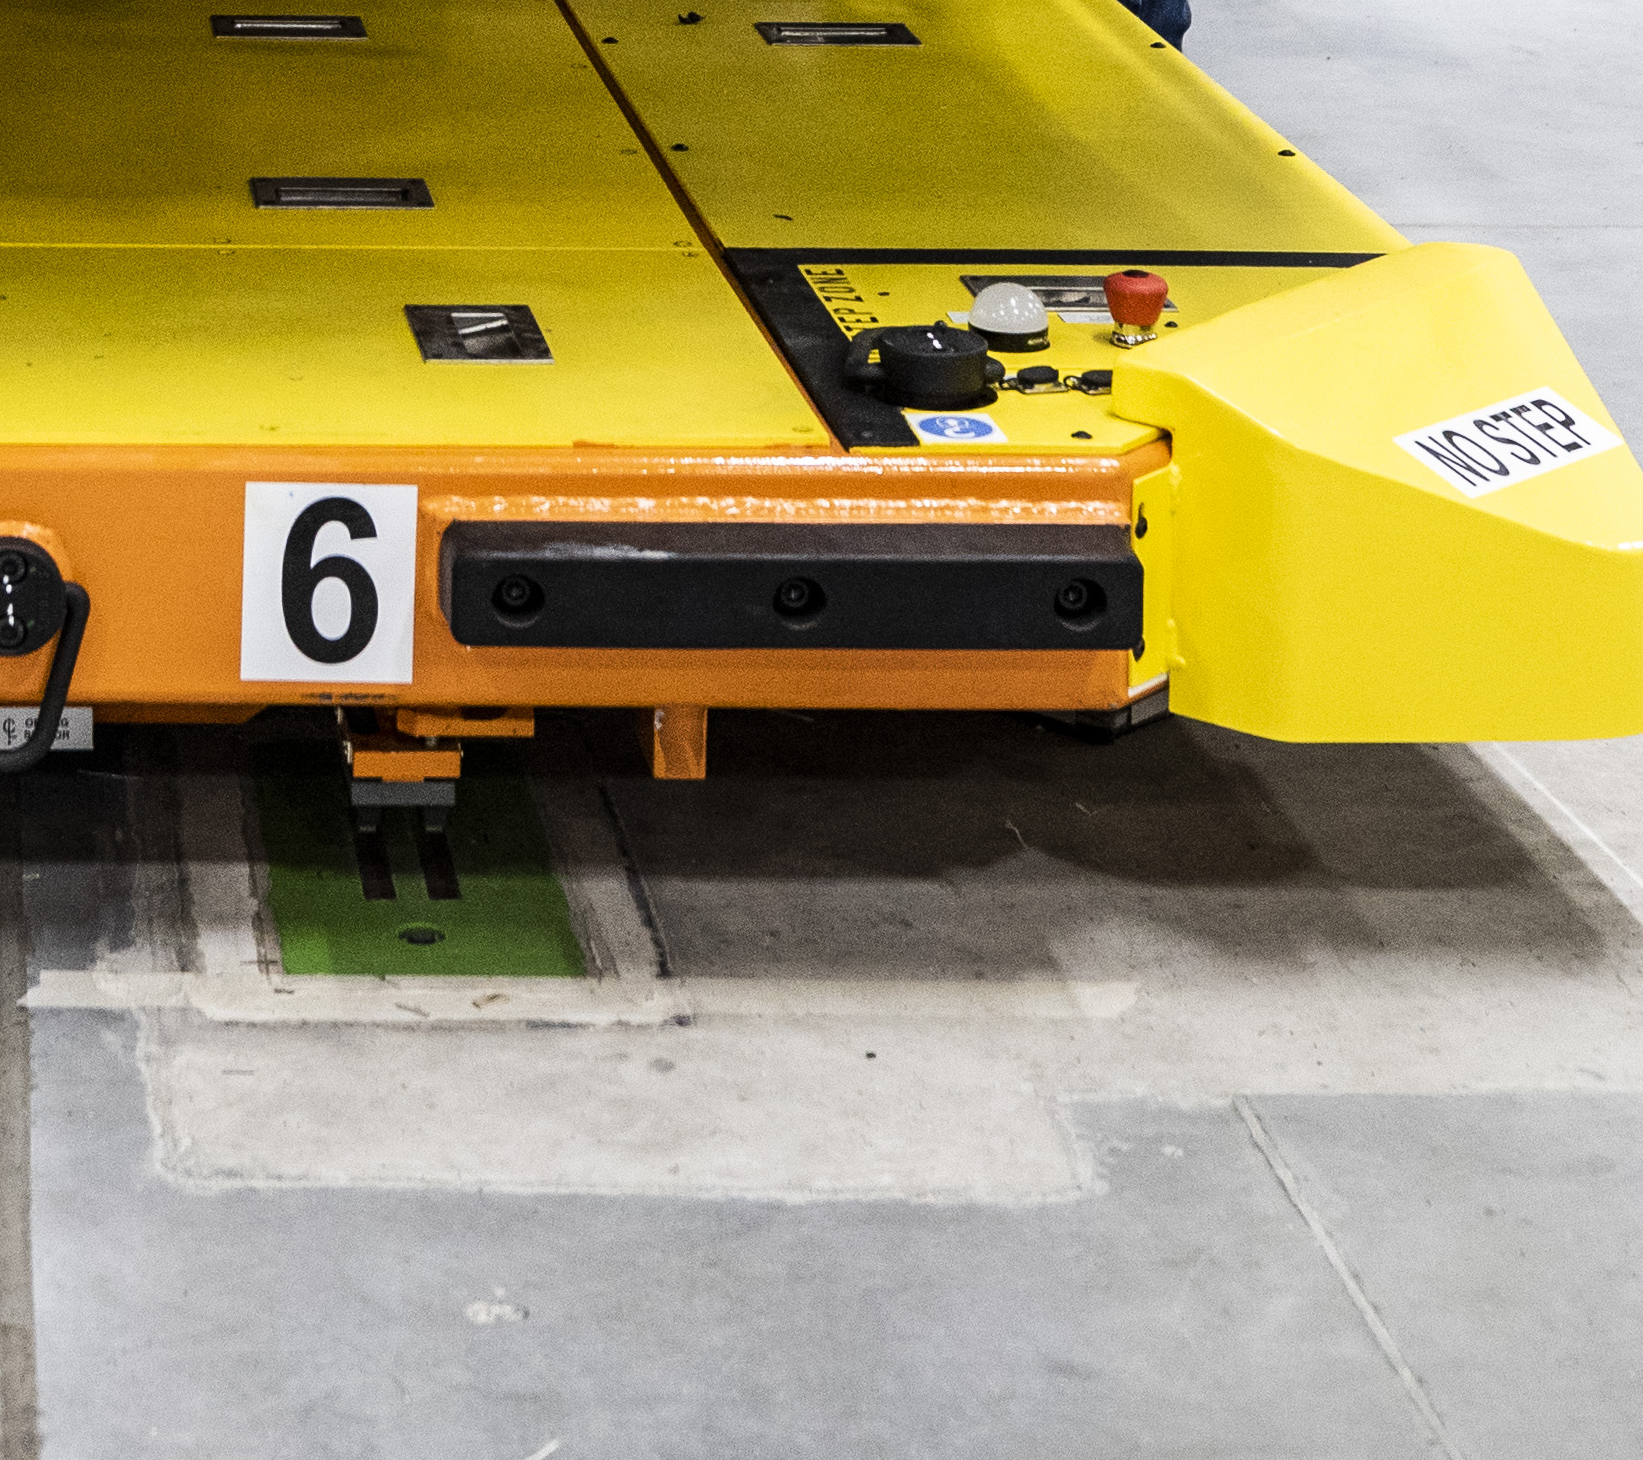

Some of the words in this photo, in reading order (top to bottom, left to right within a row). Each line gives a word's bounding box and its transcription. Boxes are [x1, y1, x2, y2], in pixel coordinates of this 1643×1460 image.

[804, 267, 864, 304] ZONE
[1414, 430, 1510, 486] NO
[1473, 398, 1592, 465] STEP
[280, 497, 379, 665] 6
